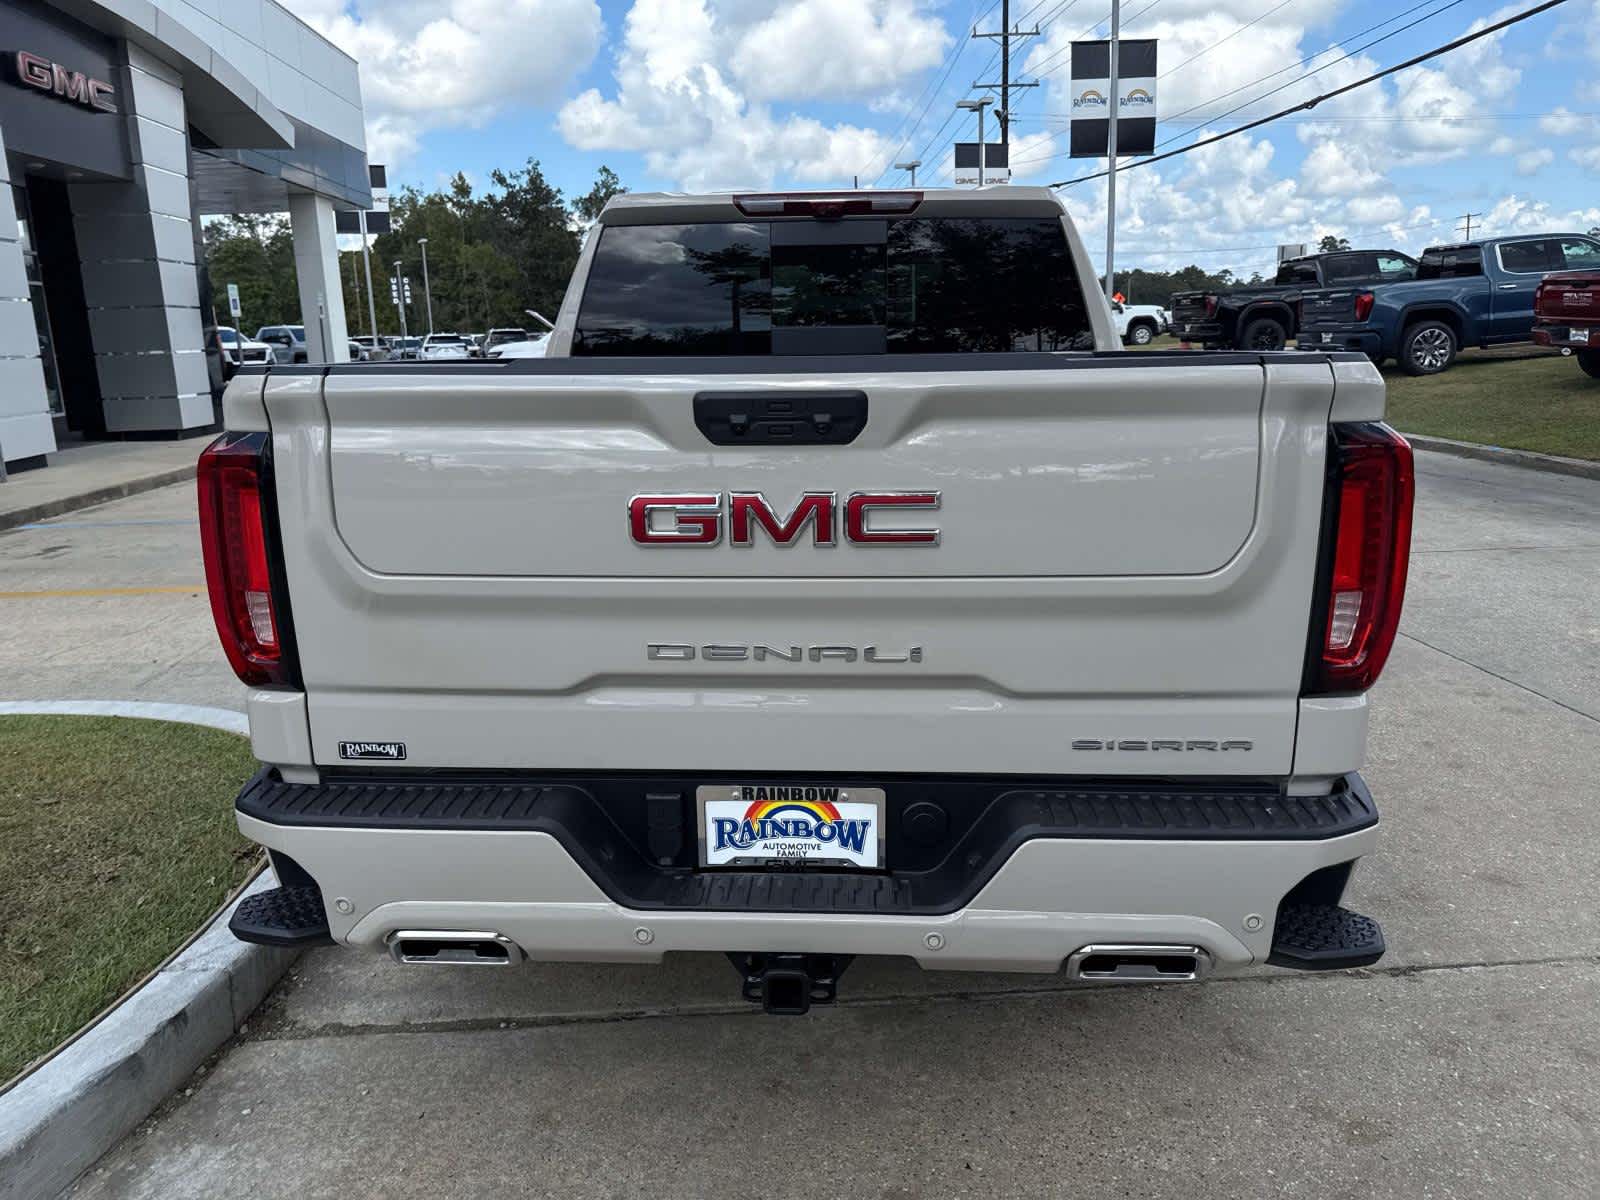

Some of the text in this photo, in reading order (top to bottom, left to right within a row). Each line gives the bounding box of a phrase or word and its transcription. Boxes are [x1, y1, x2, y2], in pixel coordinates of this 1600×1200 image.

[17, 50, 118, 113] GMC
[628, 491, 942, 548] GMC
[647, 643, 922, 662] DENALI
[345, 743, 399, 757] RAINBOW
[1071, 739, 1253, 751] SIERRA
[742, 786, 839, 802] RAINBOW
[712, 817, 871, 855] RAINBOW
[762, 843, 822, 851] AUTOMOTIVE
[776, 850, 808, 858] FAMILY
